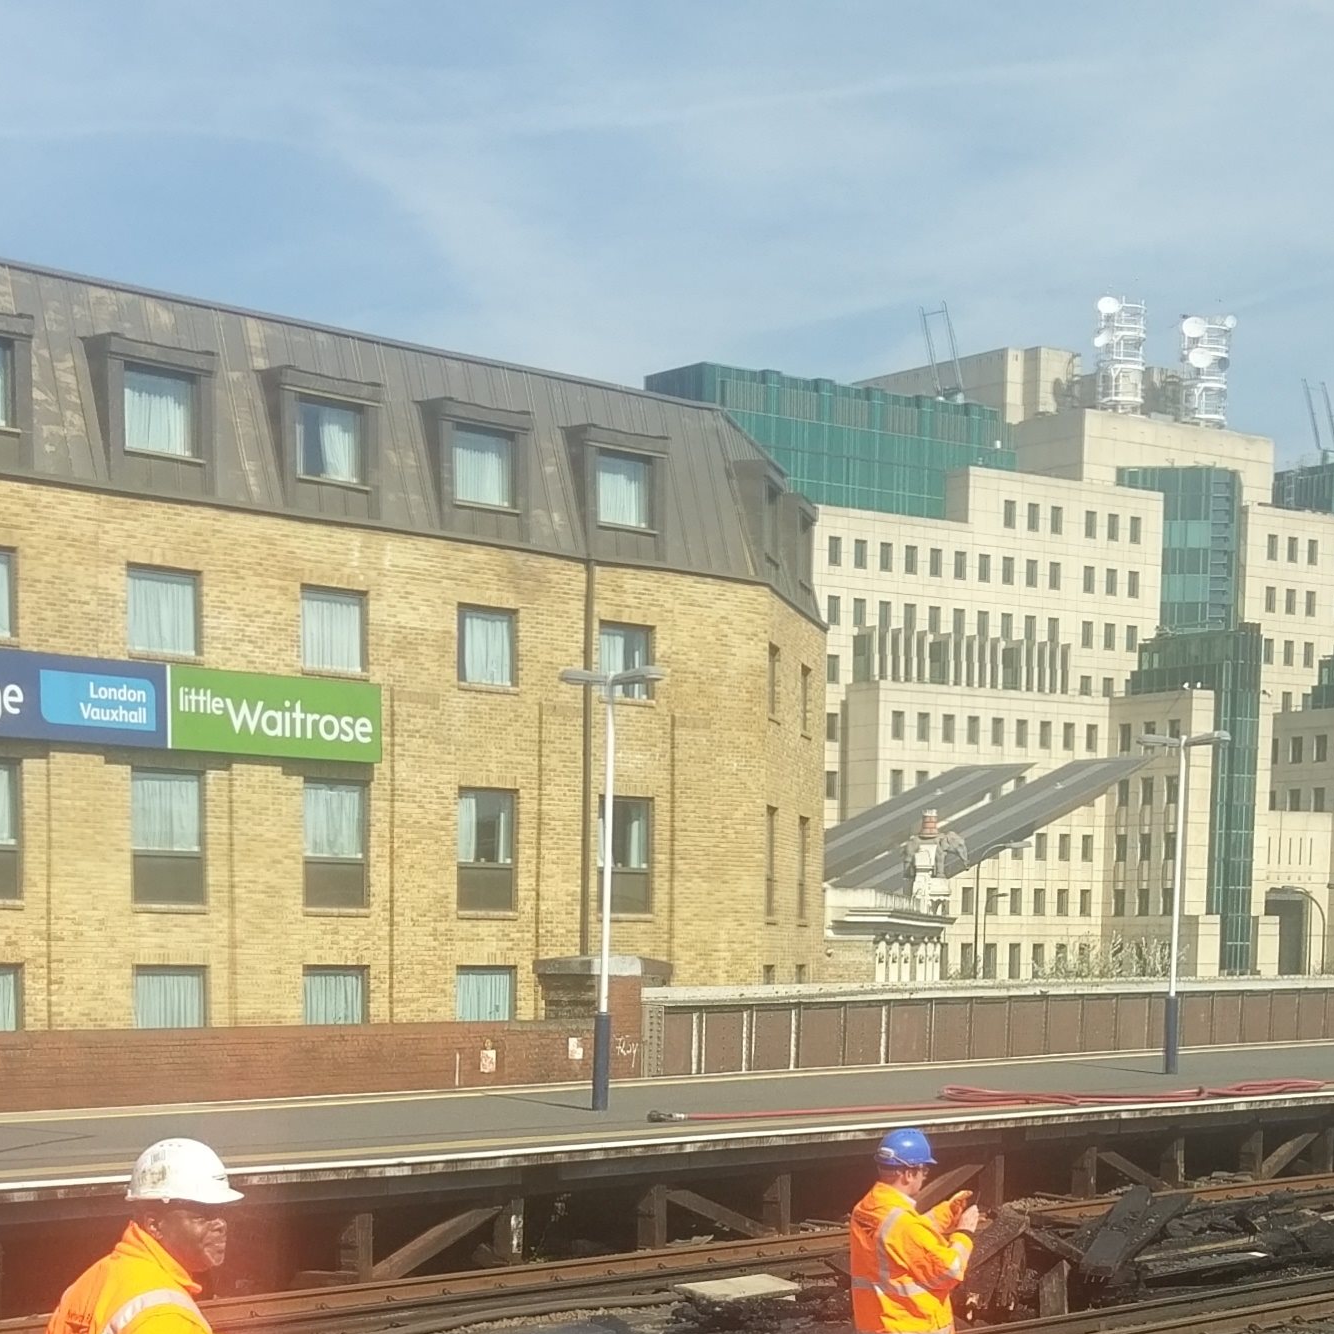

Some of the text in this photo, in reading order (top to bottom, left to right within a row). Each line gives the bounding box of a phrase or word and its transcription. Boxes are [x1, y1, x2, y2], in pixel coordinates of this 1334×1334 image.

[89, 681, 147, 703] London
[79, 702, 147, 724] Vauxhall
[179, 686, 373, 743] little Waitrose
